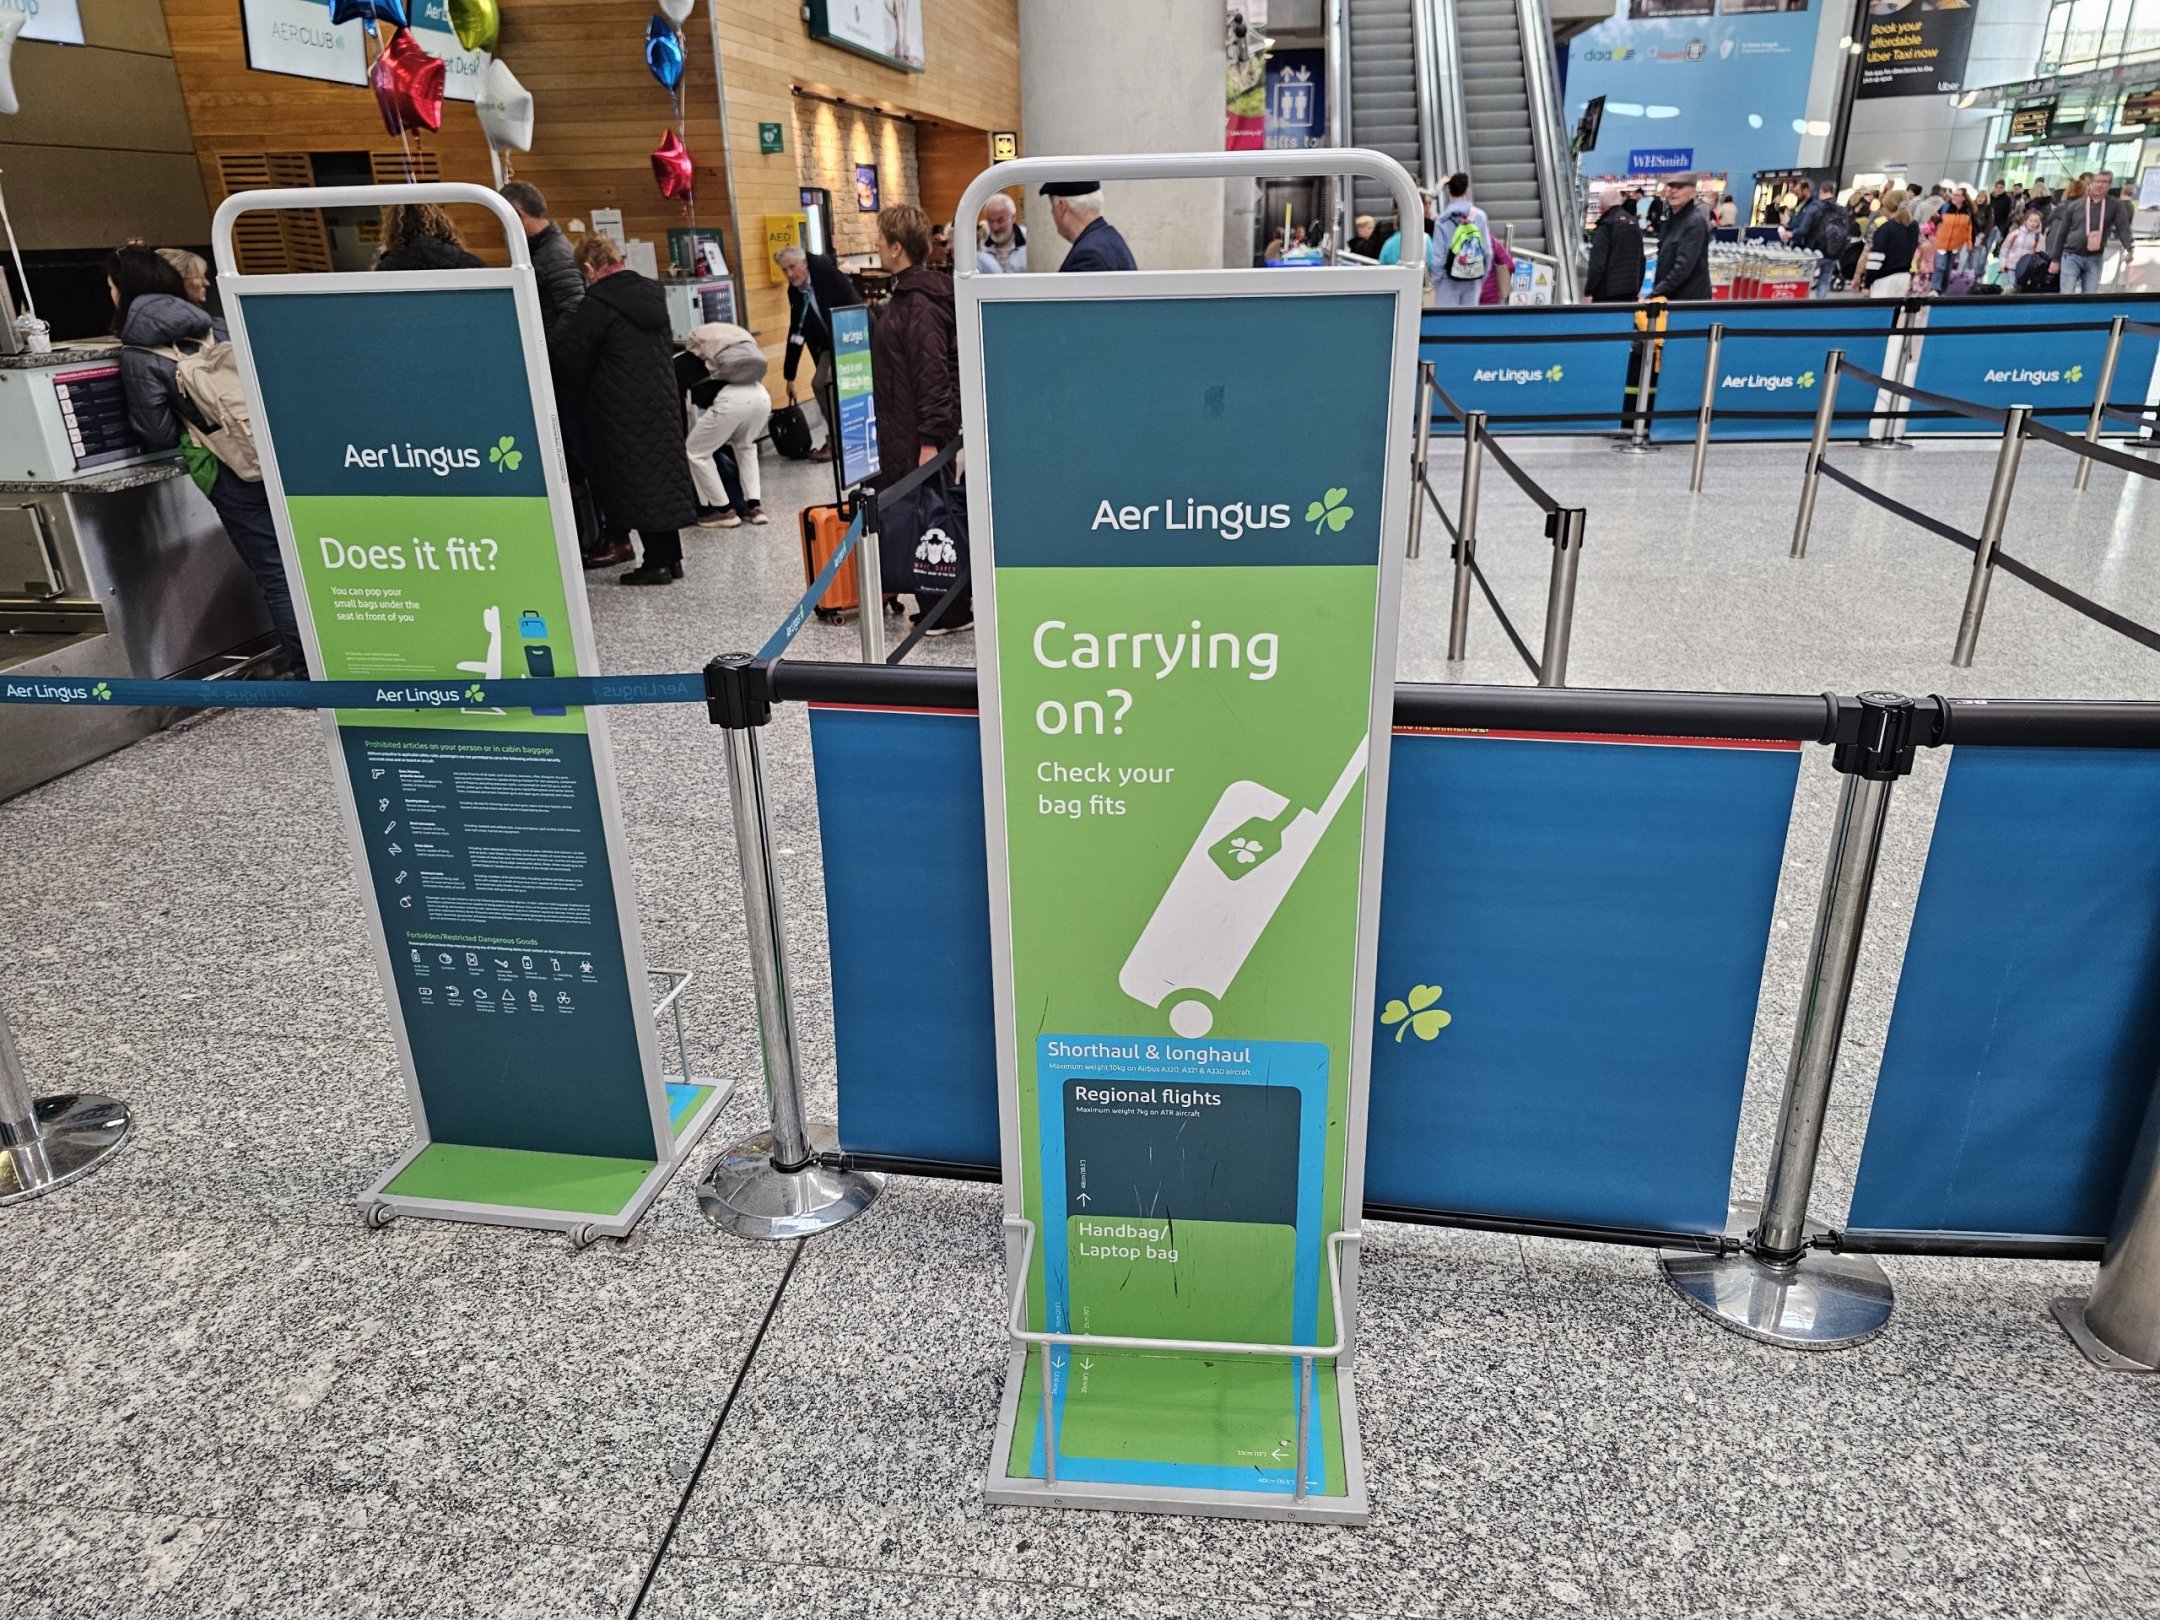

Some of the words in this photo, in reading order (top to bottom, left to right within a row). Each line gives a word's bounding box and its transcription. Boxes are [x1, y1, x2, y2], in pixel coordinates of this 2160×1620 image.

[1871, 23, 1897, 35] Book
[1898, 21, 1923, 34] your
[1869, 34, 1923, 49] affordable
[1866, 52, 1892, 63] Uber
[1893, 48, 1913, 60] Taxi
[1914, 48, 1939, 59] now
[1937, 81, 1960, 91] Uber
[1632, 154, 1689, 168] WHSmith
[769, 233, 791, 242] AED
[1473, 369, 1499, 381] Aer
[1499, 368, 1543, 384] Lingus
[1722, 375, 1748, 388] Aer
[1749, 374, 1793, 391] Lingus
[1984, 369, 2011, 383] Aer
[2012, 368, 2060, 386] Lingus
[344, 444, 390, 469] Aer
[393, 442, 480, 476] Lingus
[1091, 499, 1159, 531] Aer
[1166, 497, 1290, 539] Lingus
[319, 537, 407, 570] Does
[412, 537, 440, 570] it
[446, 537, 499, 571] fit?
[331, 586, 347, 596] You
[349, 588, 363, 596] can
[365, 588, 382, 598] pop
[383, 588, 402, 598] your
[334, 599, 357, 609] small
[358, 599, 378, 611] bags
[379, 600, 404, 610] under
[405, 600, 420, 610] the
[336, 612, 355, 621] seat
[356, 612, 364, 621] in
[365, 612, 387, 622] front
[387, 612, 396, 622] of
[398, 614, 415, 623] you
[1033, 620, 1279, 680] Carrying
[7, 683, 32, 697] Aer
[34, 684, 88, 703] Lingus
[376, 688, 404, 702] Aer
[406, 688, 460, 706] Lingus
[1035, 689, 1133, 735] on?
[364, 740, 401, 748] Prohibited
[403, 742, 428, 750] articles
[440, 744, 456, 752] your
[458, 745, 483, 753] person
[493, 744, 500, 752] in
[502, 745, 521, 753] cabin
[522, 746, 554, 755] baggage
[1037, 761, 1110, 784] Check
[1118, 765, 1174, 788] your
[1038, 793, 1082, 819] bag
[1089, 793, 1127, 816] fits
[406, 931, 477, 942] Forbidden/Restricted
[478, 935, 515, 945] Dangerous
[515, 938, 538, 946] Goods
[1048, 1042, 1140, 1059] Shorthaul
[1145, 1045, 1160, 1060] &
[1166, 1047, 1251, 1064] longhaul
[1085, 1063, 1109, 1072] weight
[1110, 1064, 1126, 1073] 10kg
[1138, 1065, 1160, 1073] Airbus
[1226, 1068, 1251, 1077] aircraft
[1075, 1086, 1157, 1105] Regional
[1162, 1088, 1222, 1108] flights
[1076, 1106, 1110, 1114] Maximum
[1111, 1108, 1135, 1116] weight
[1136, 1109, 1148, 1117] 7kg
[1175, 1109, 1201, 1118] aircraft
[1080, 1222, 1168, 1242] Handbag/
[1080, 1242, 1140, 1260] Laptop
[1146, 1245, 1178, 1262] bag
